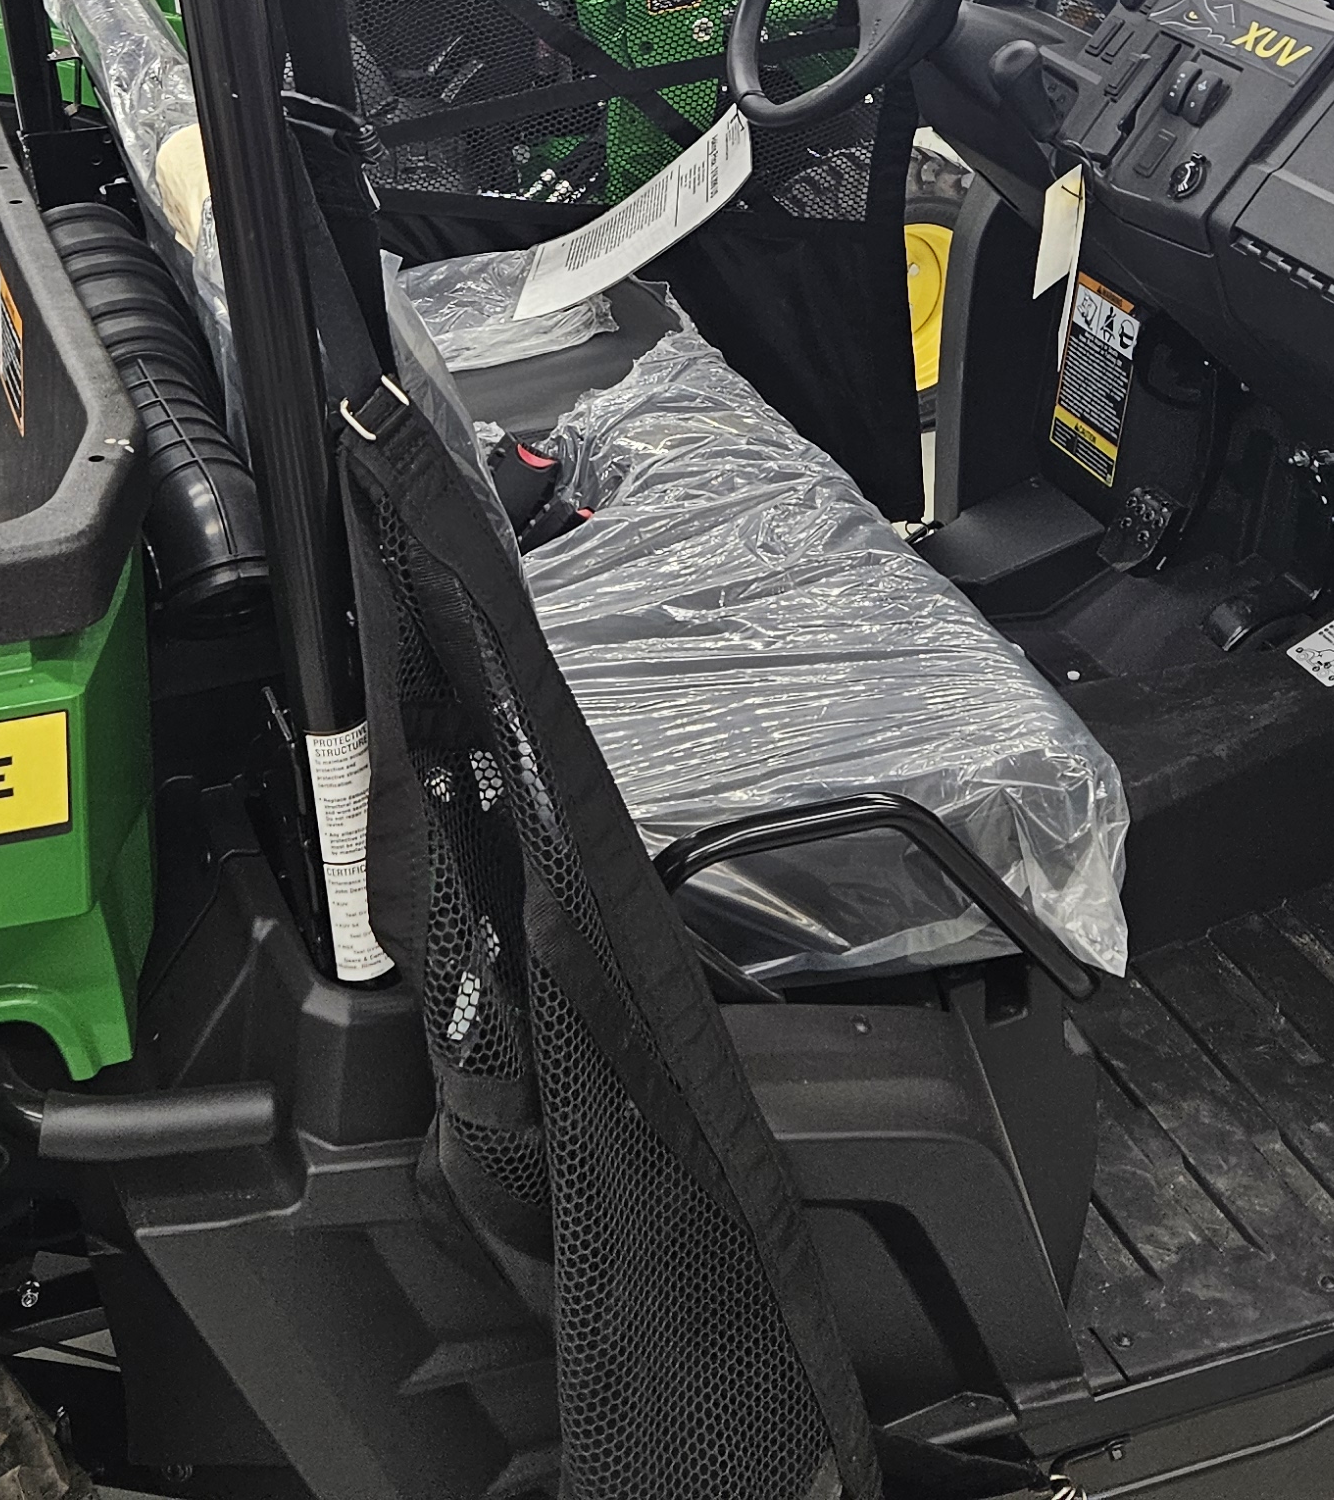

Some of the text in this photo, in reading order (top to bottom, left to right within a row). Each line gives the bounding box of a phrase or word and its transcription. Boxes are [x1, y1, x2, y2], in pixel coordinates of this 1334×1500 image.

[1231, 20, 1313, 68] XUV
[313, 724, 367, 747] PROTECTIVE
[315, 735, 368, 757] STRUCTURE
[326, 864, 366, 877] CERTIFIC
